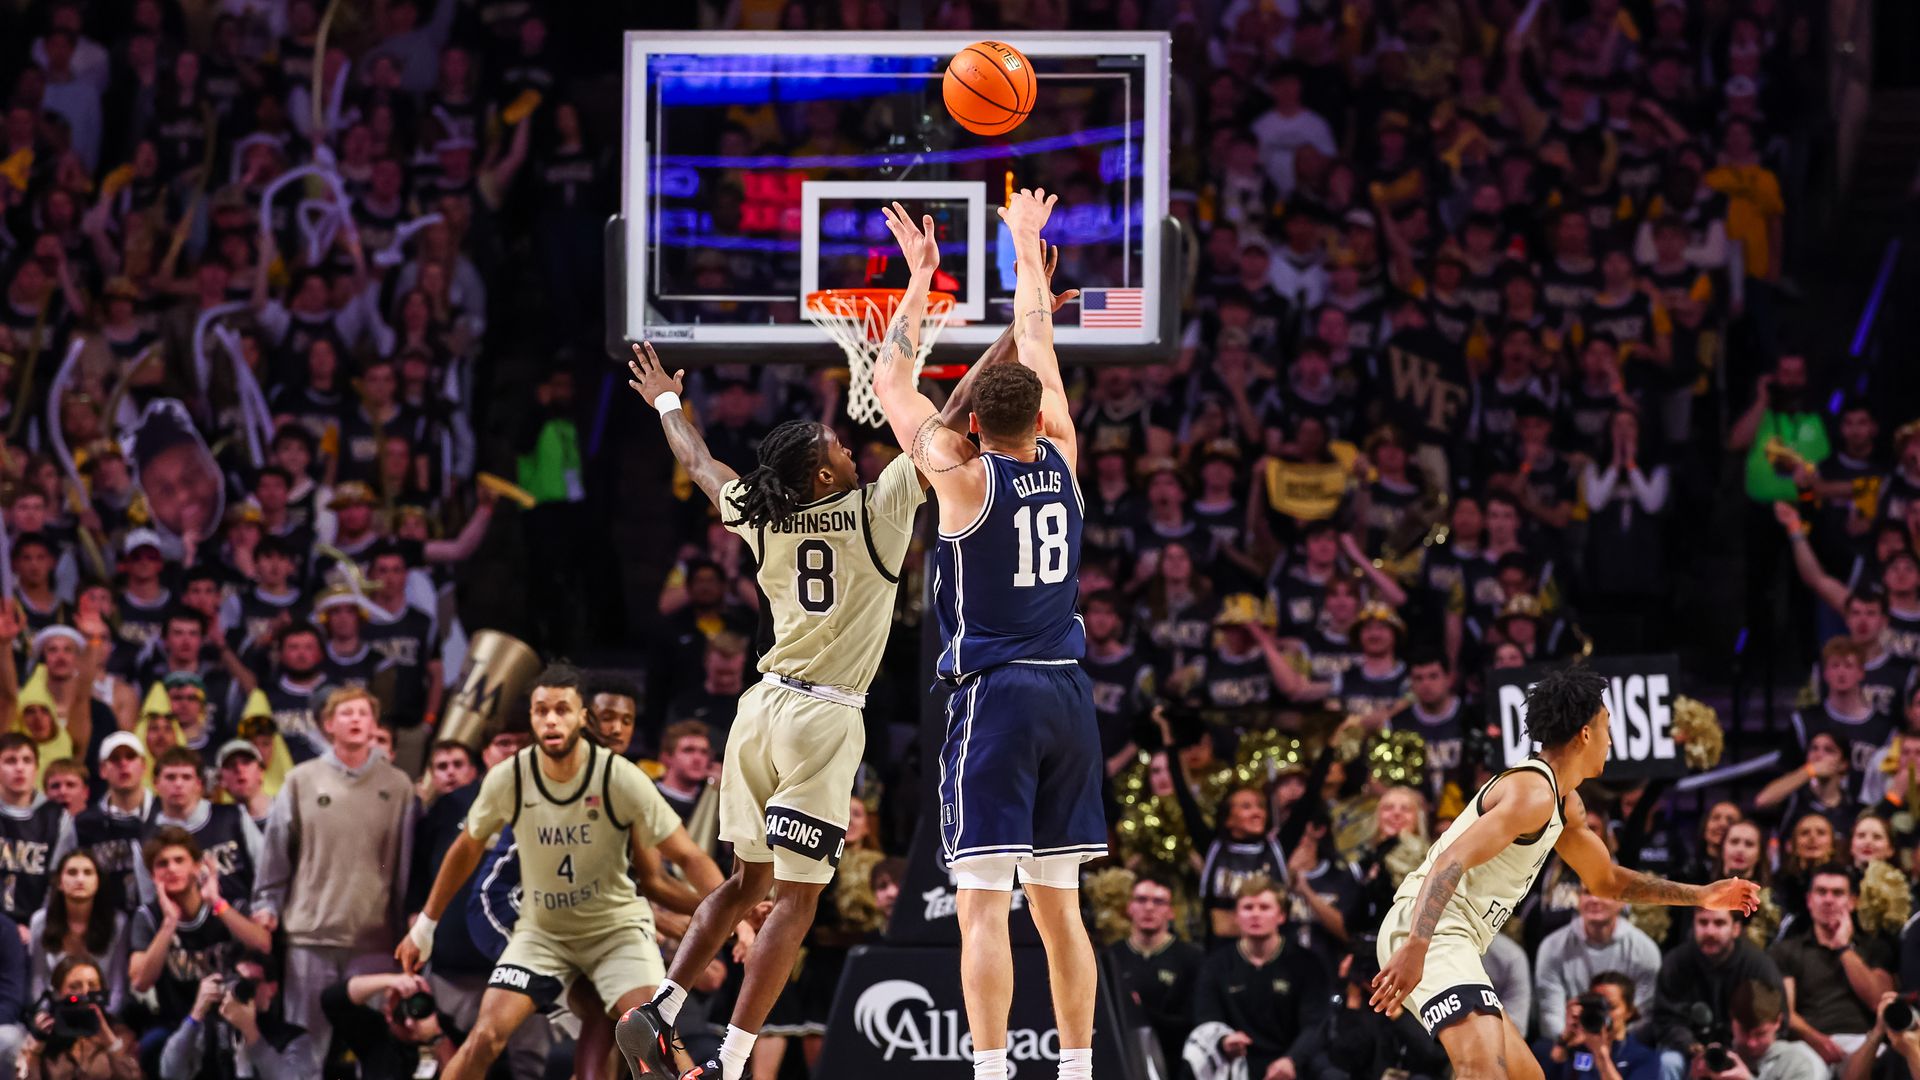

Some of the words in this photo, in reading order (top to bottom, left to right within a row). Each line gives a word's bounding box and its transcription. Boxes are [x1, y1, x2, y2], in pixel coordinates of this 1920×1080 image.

[1012, 471, 1062, 499] GILLIS
[1013, 502, 1069, 587] 18
[796, 538, 838, 616] 8
[1499, 673, 1676, 768] DNSE
[537, 824, 592, 845] WAKE
[0, 838, 49, 875] AKE
[557, 854, 575, 884] 4
[534, 880, 600, 910] FOREST
[1423, 993, 1462, 1036] CONS
